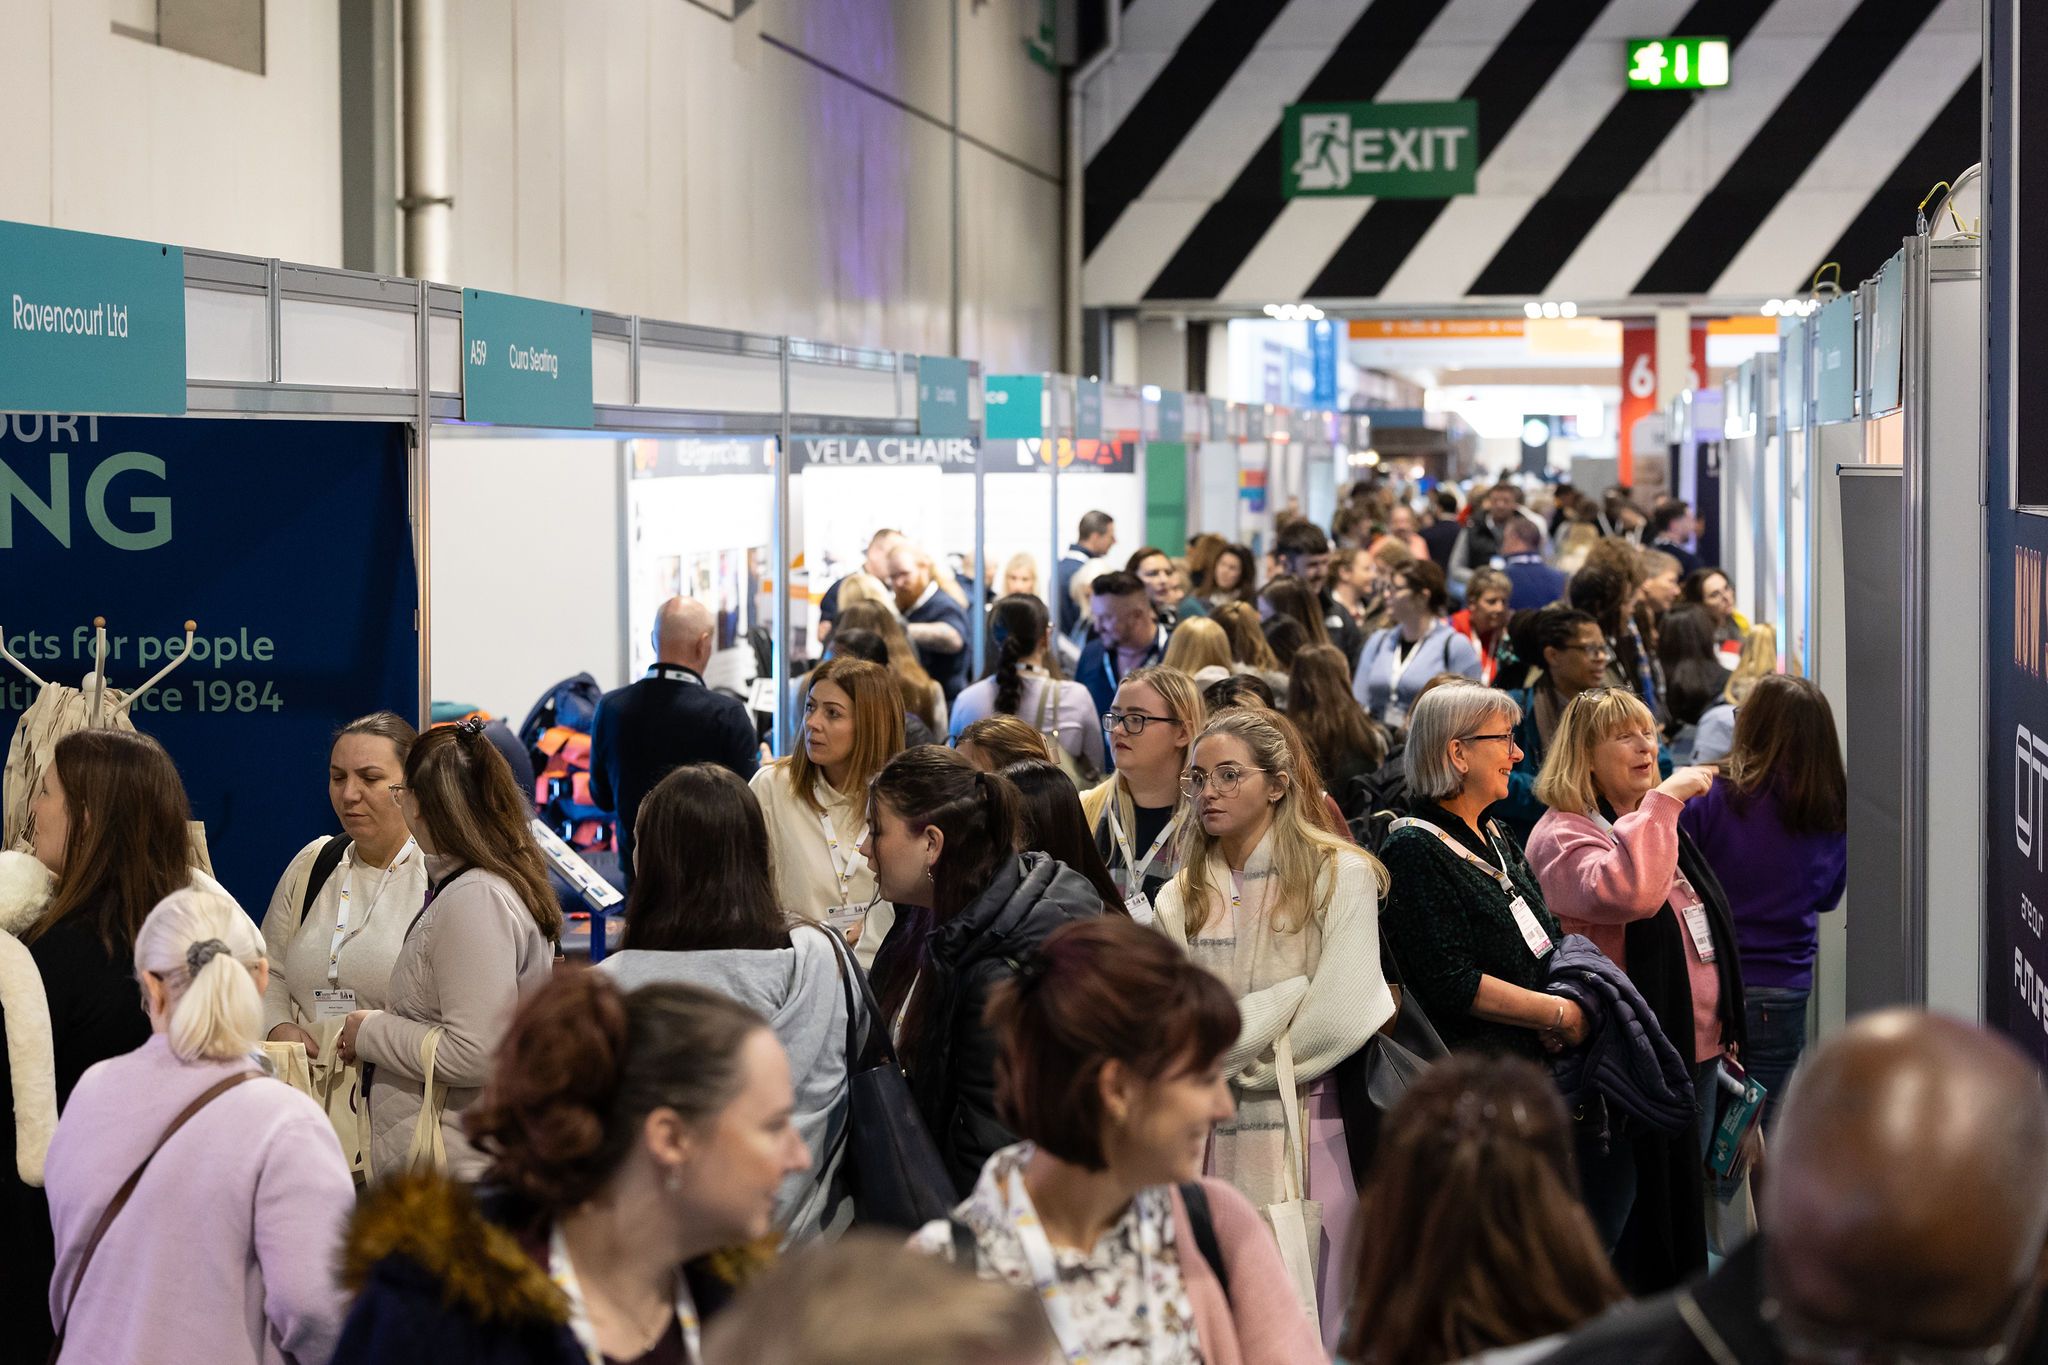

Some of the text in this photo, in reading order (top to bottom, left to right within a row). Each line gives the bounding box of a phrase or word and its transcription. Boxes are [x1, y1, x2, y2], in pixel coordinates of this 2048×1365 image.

[1353, 126, 1469, 173] EXIT
[12, 294, 128, 338] Ravencourt Ltd
[470, 340, 487, 366] A59
[529, 346, 558, 379] Seating
[1629, 353, 1655, 398] 6
[805, 437, 977, 465] VELA CHAIRS
[0, 451, 172, 551] NG
[73, 626, 128, 660] for
[139, 627, 275, 669] people
[193, 681, 284, 712] 1984
